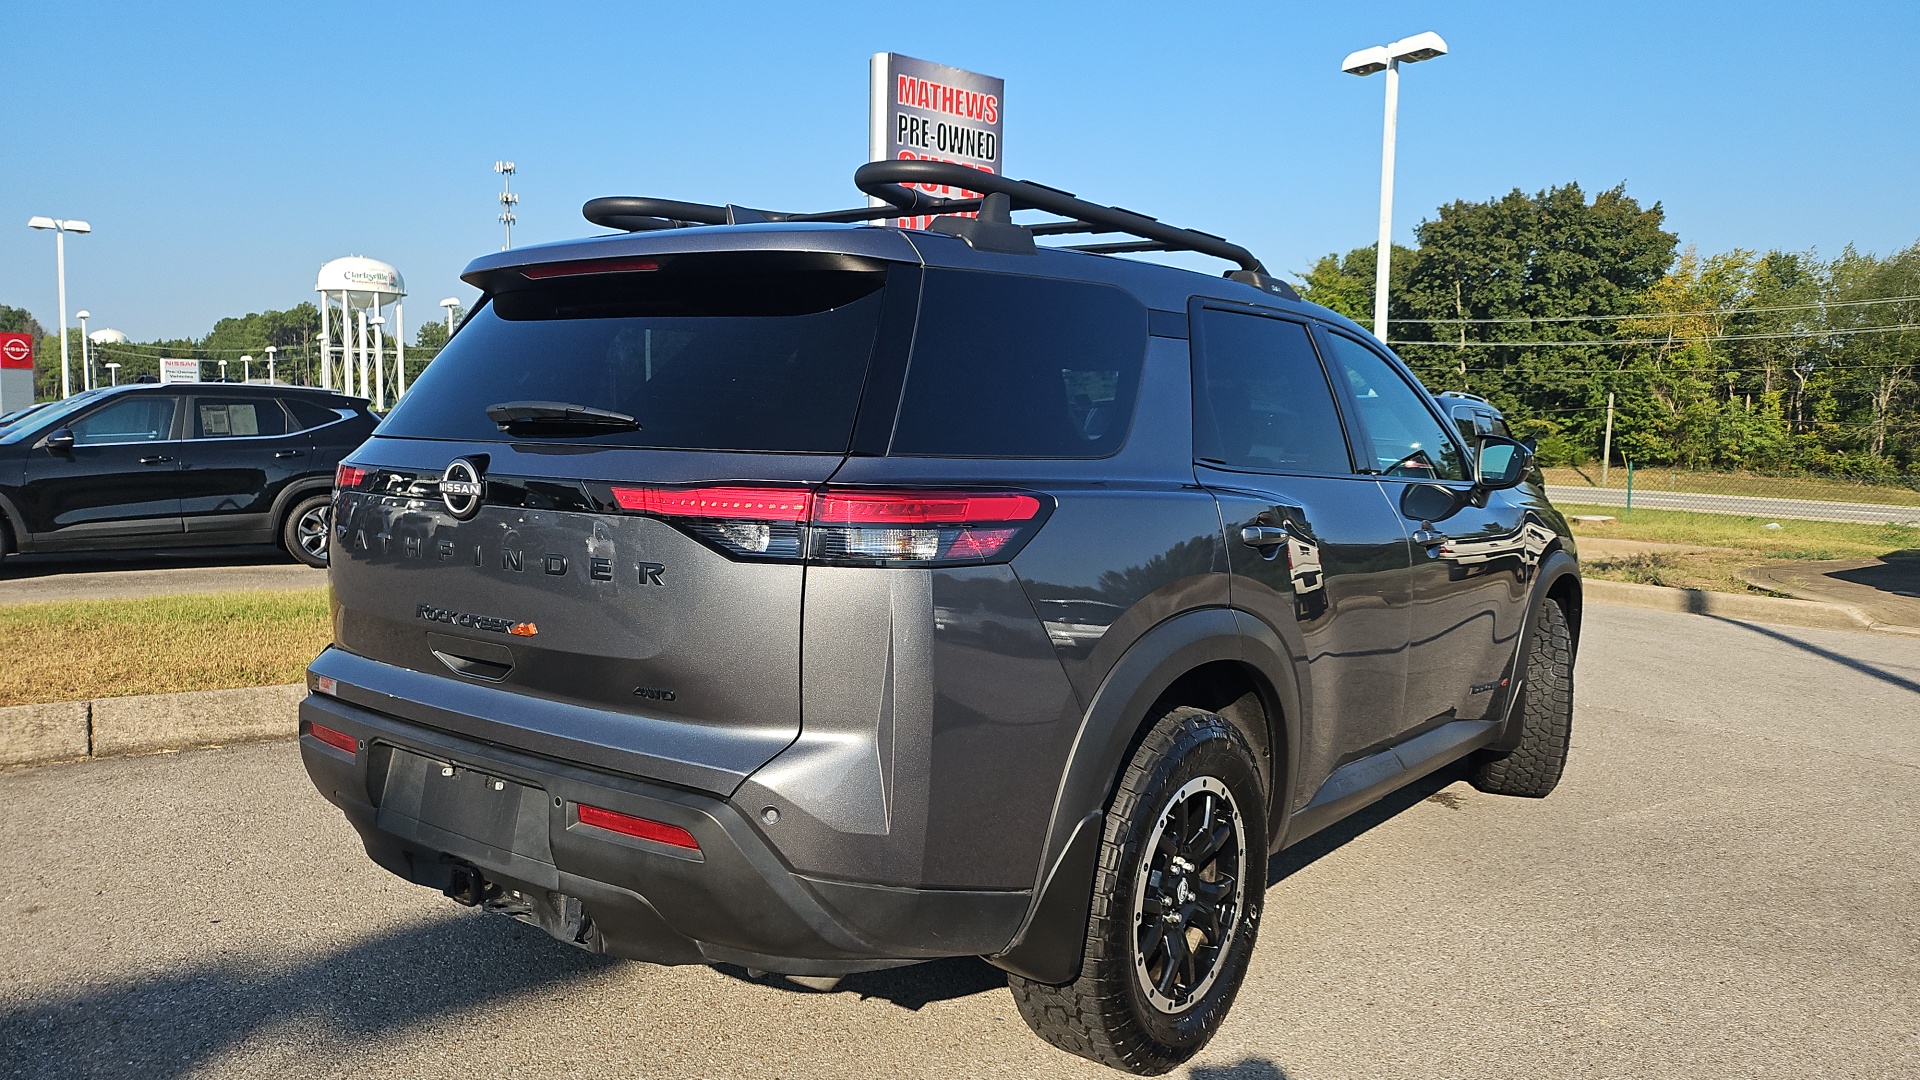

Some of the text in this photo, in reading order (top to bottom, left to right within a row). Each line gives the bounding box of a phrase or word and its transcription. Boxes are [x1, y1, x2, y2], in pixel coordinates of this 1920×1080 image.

[897, 74, 998, 125] MATHEWS
[897, 112, 997, 162] PRE-OWNED
[439, 482, 480, 494] NISSAN
[336, 524, 666, 587] PATHFINDER
[460, 613, 515, 634] CREEK
[632, 686, 677, 701] 4WD
